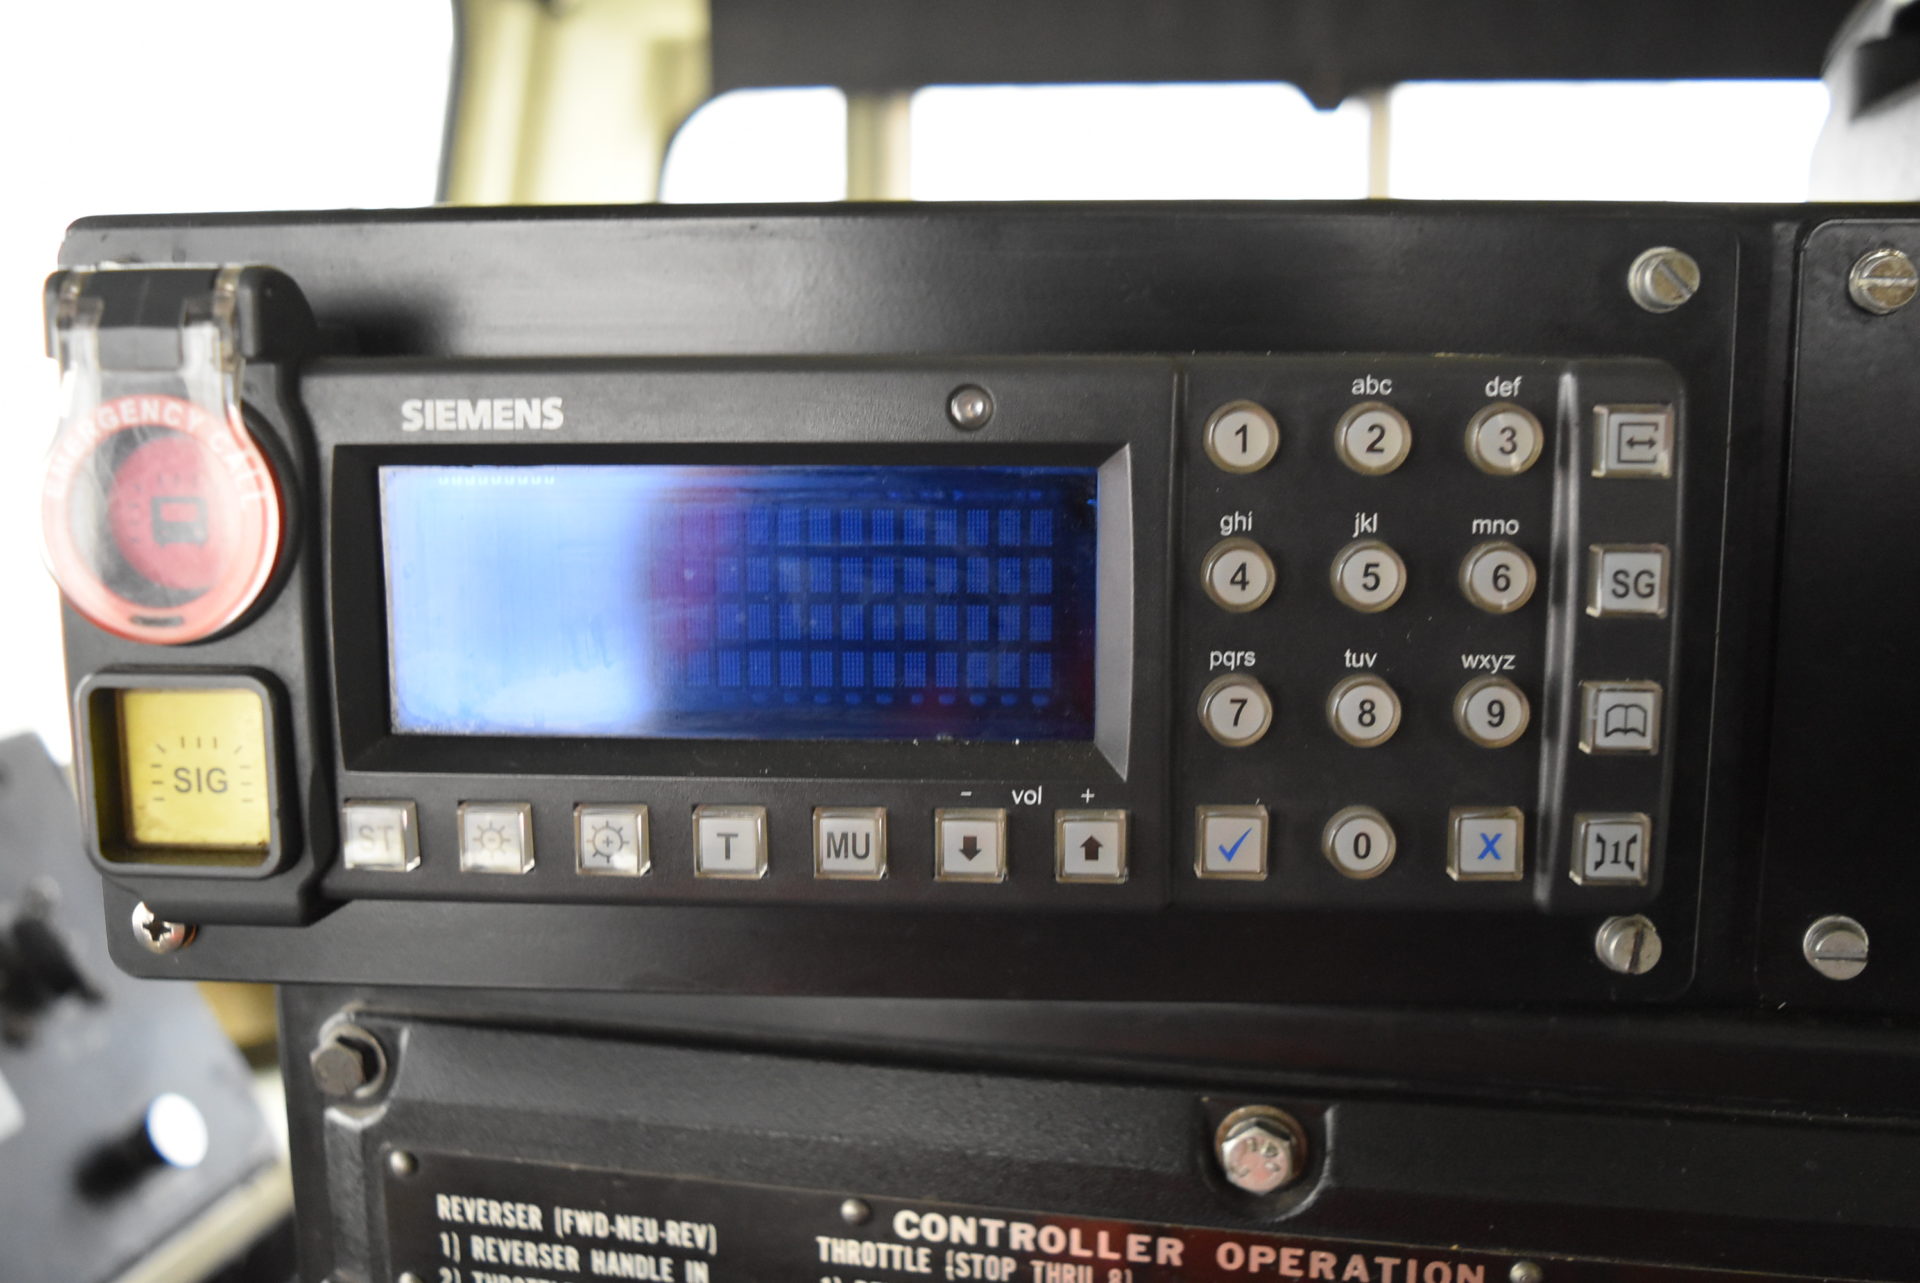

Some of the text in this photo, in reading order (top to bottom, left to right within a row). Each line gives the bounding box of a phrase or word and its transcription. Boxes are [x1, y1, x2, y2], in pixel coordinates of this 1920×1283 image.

[1351, 374, 1392, 395] abc
[1485, 376, 1522, 397] def
[401, 396, 564, 432] SIEMENS
[1234, 424, 1248, 454] 1
[1365, 423, 1386, 454] 2
[1498, 426, 1519, 455] 3
[1220, 511, 1253, 536] ghi
[1352, 512, 1378, 538] jkl
[1472, 518, 1520, 535] mno
[1229, 562, 1250, 591] 4
[1362, 562, 1381, 592] 5
[1492, 563, 1511, 593] 6
[1611, 569, 1655, 599] SG
[1209, 649, 1257, 671] pqrs
[1344, 649, 1377, 668] tuv
[1461, 654, 1517, 671] wxyz
[1229, 698, 1248, 727] 7
[1357, 698, 1376, 728] 8
[1487, 699, 1506, 728] 9
[173, 766, 228, 794] SIG
[1011, 785, 1042, 805] vol
[357, 824, 395, 852] ST
[716, 833, 739, 861] T
[826, 832, 870, 860] MU
[1353, 832, 1372, 860] 0
[436, 1194, 543, 1231] REVERSER
[440, 1232, 461, 1262] 1)
[470, 1235, 580, 1273] REVERSER
[590, 1249, 674, 1283] HANDLE
[685, 1260, 709, 1283] IN
[815, 1236, 932, 1274] THROTTLE
[1030, 1259, 1093, 1283] THRU
[892, 1210, 1485, 1283] CONTROLLER OPERATION
